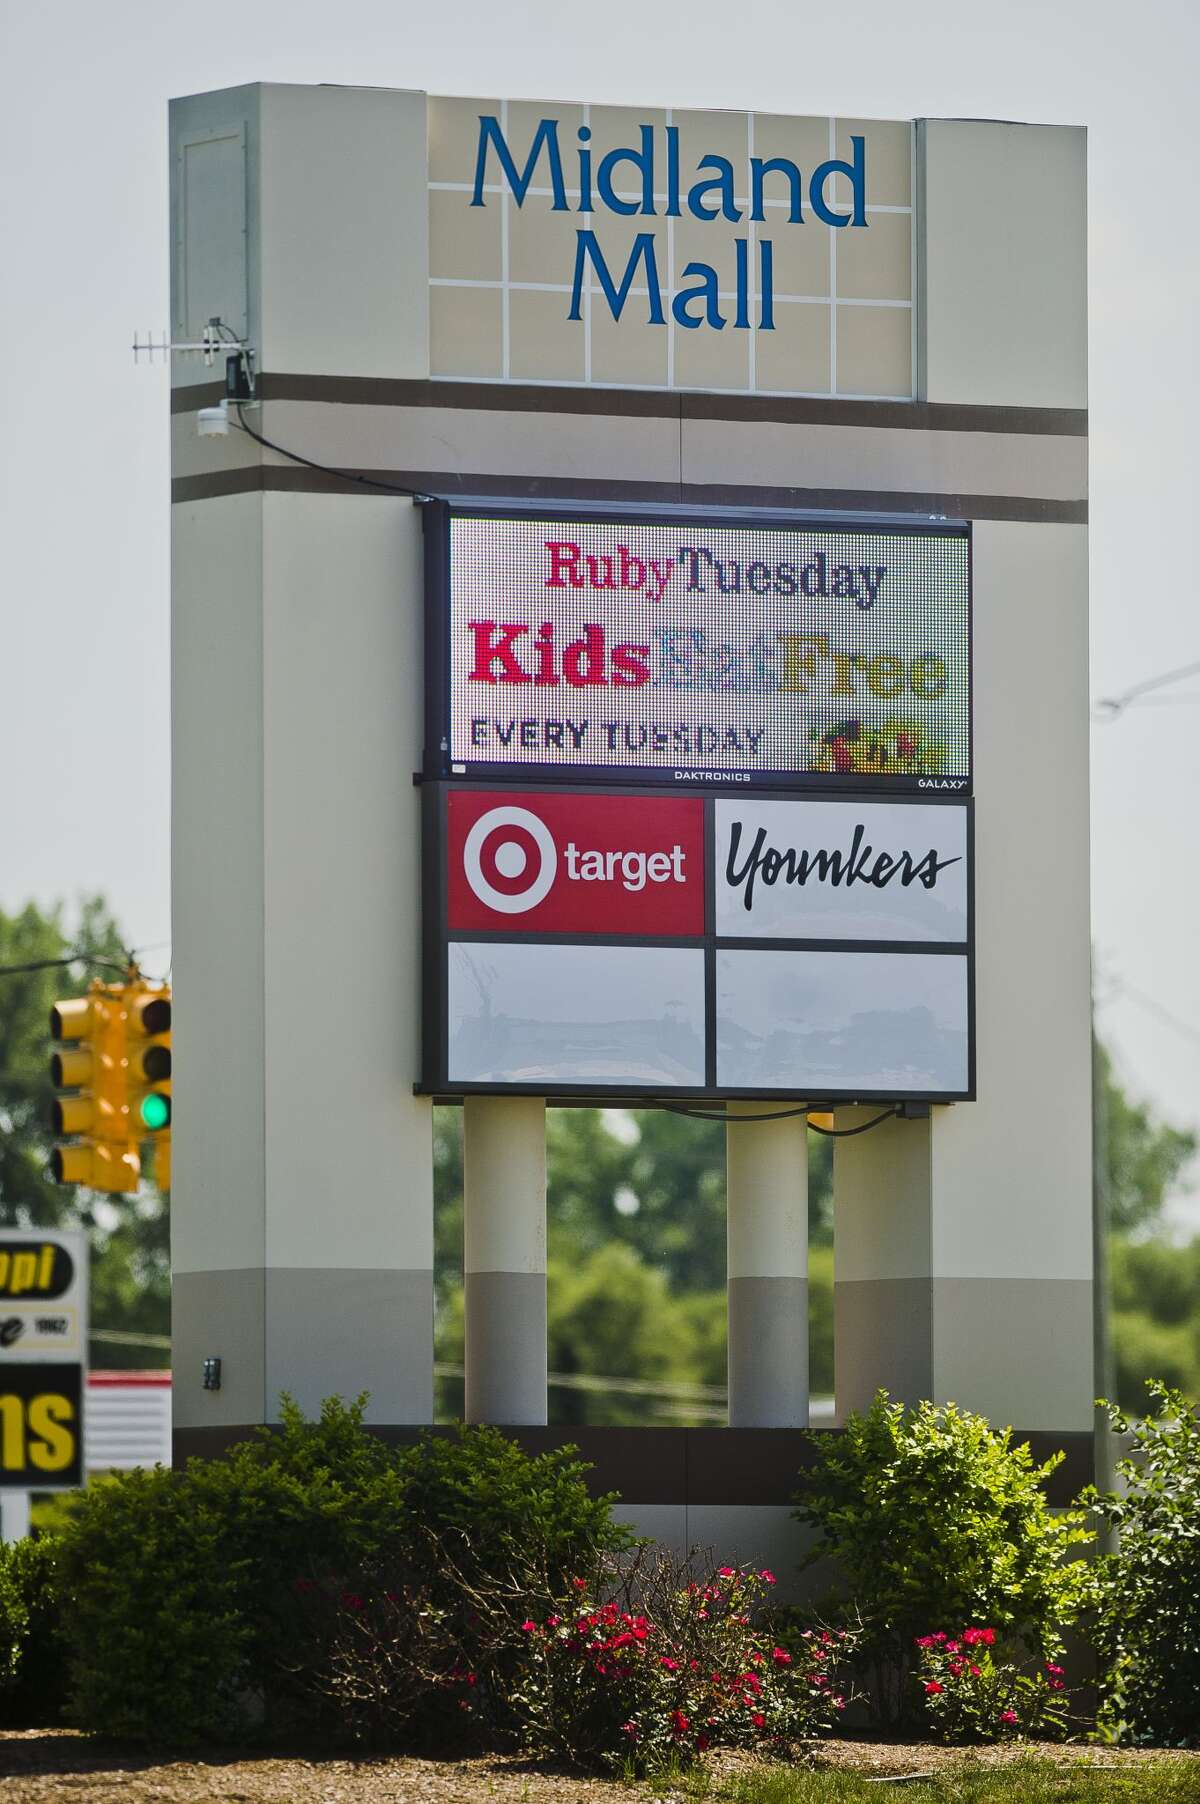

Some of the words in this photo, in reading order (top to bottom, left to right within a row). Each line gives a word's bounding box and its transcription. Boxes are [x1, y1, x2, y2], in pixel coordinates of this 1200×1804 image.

[469, 115, 870, 228] Midland
[566, 229, 776, 331] Mall
[467, 620, 651, 688] Kids
[470, 717, 588, 751] EVERY
[600, 720, 765, 755] TUESDAY
[674, 771, 751, 782] DAKTRONICS
[918, 778, 966, 789] GALAXY
[563, 842, 686, 892] target
[725, 821, 963, 912] Younkers
